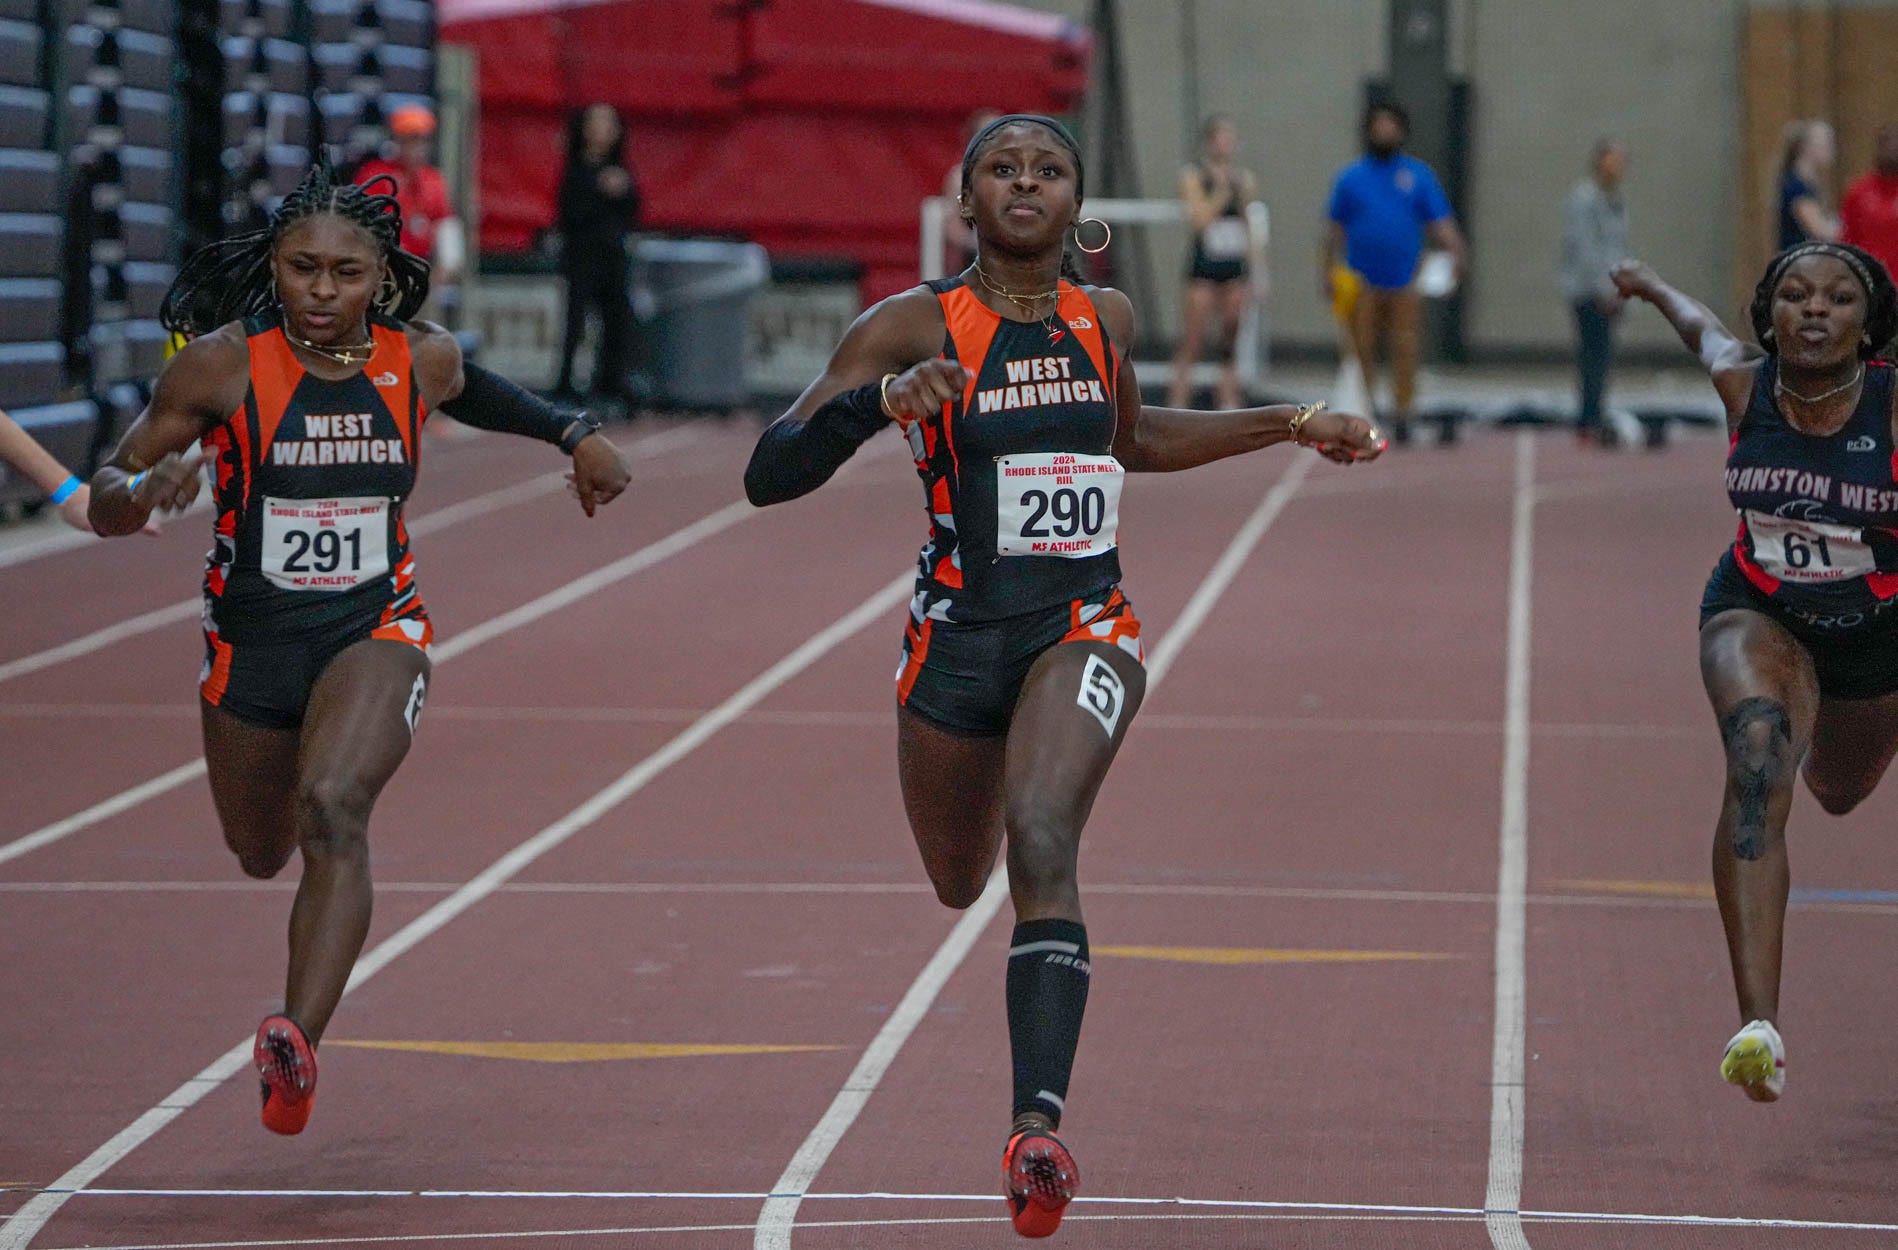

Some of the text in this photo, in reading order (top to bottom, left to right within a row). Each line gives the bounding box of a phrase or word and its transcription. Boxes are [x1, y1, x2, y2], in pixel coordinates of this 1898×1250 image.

[1005, 355, 1071, 384] WEST
[977, 380, 1105, 414] WARWICK
[304, 413, 373, 438] WEST
[272, 439, 404, 466] WARWICK
[1053, 455, 1076, 465] 2024
[1005, 464, 1117, 476] RHODE ISLAND STATE MEET
[1056, 476, 1074, 485] RIIL
[1725, 466, 1832, 501] RANSTON
[302, 509, 332, 518] ISLAND
[1020, 486, 1105, 538] 290
[282, 527, 361, 573] 291
[1032, 539, 1092, 552] MF ATHLETIC
[1783, 531, 1832, 568] 61
[310, 575, 358, 585] ATHLETIC
[1086, 662, 1119, 719] 5
